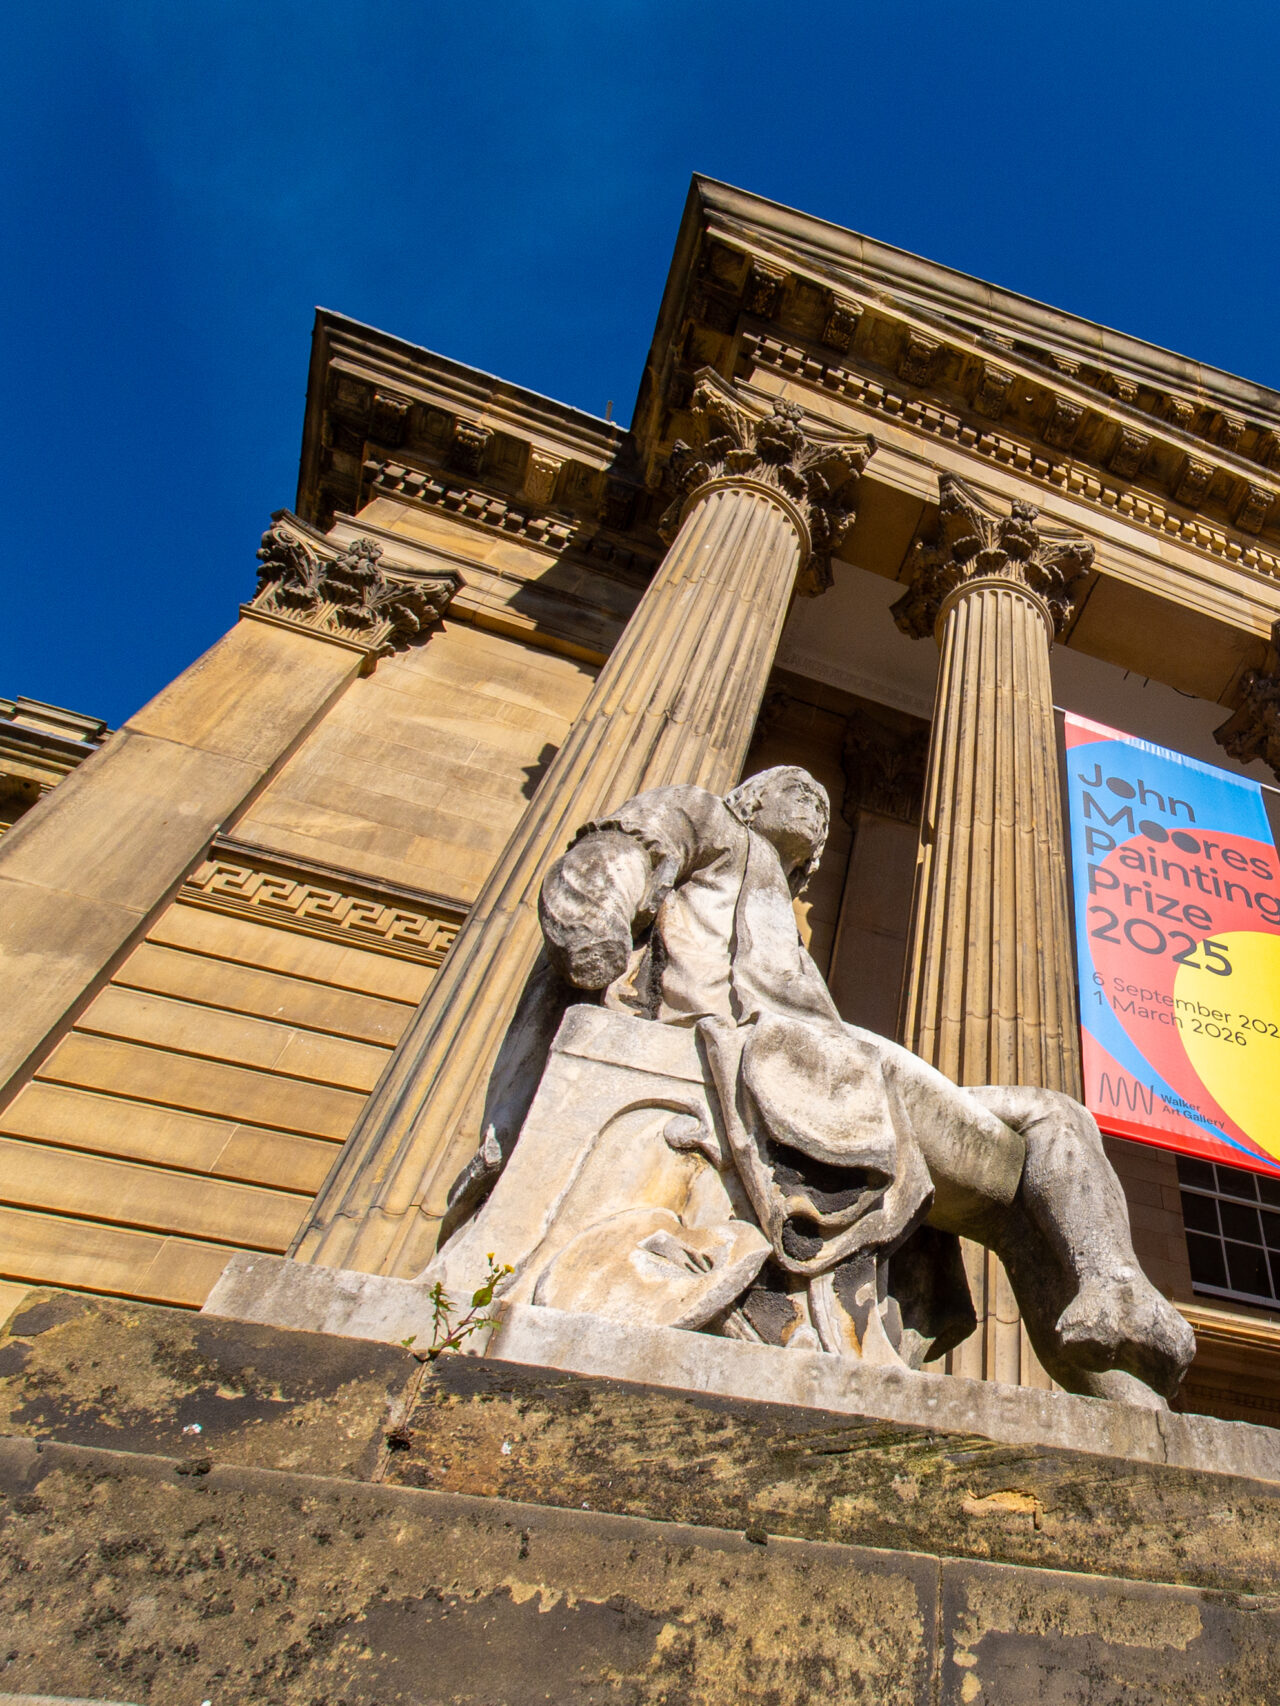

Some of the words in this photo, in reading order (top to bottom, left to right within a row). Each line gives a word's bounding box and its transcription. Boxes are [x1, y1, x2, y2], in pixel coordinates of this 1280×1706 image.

[1078, 763, 1196, 823] John
[1082, 790, 1273, 881] Moores
[1087, 862, 1213, 931] Prize
[1088, 905, 1233, 977] 2025
[1092, 971, 1105, 986] 6
[1113, 977, 1231, 1023] September
[1093, 990, 1103, 1006] 1
[1113, 995, 1183, 1029] March
[1191, 1018, 1247, 1046] 2026
[1161, 1093, 1201, 1111] Walker
[1162, 1105, 1180, 1116] Art
[1183, 1110, 1225, 1129] Gallery
